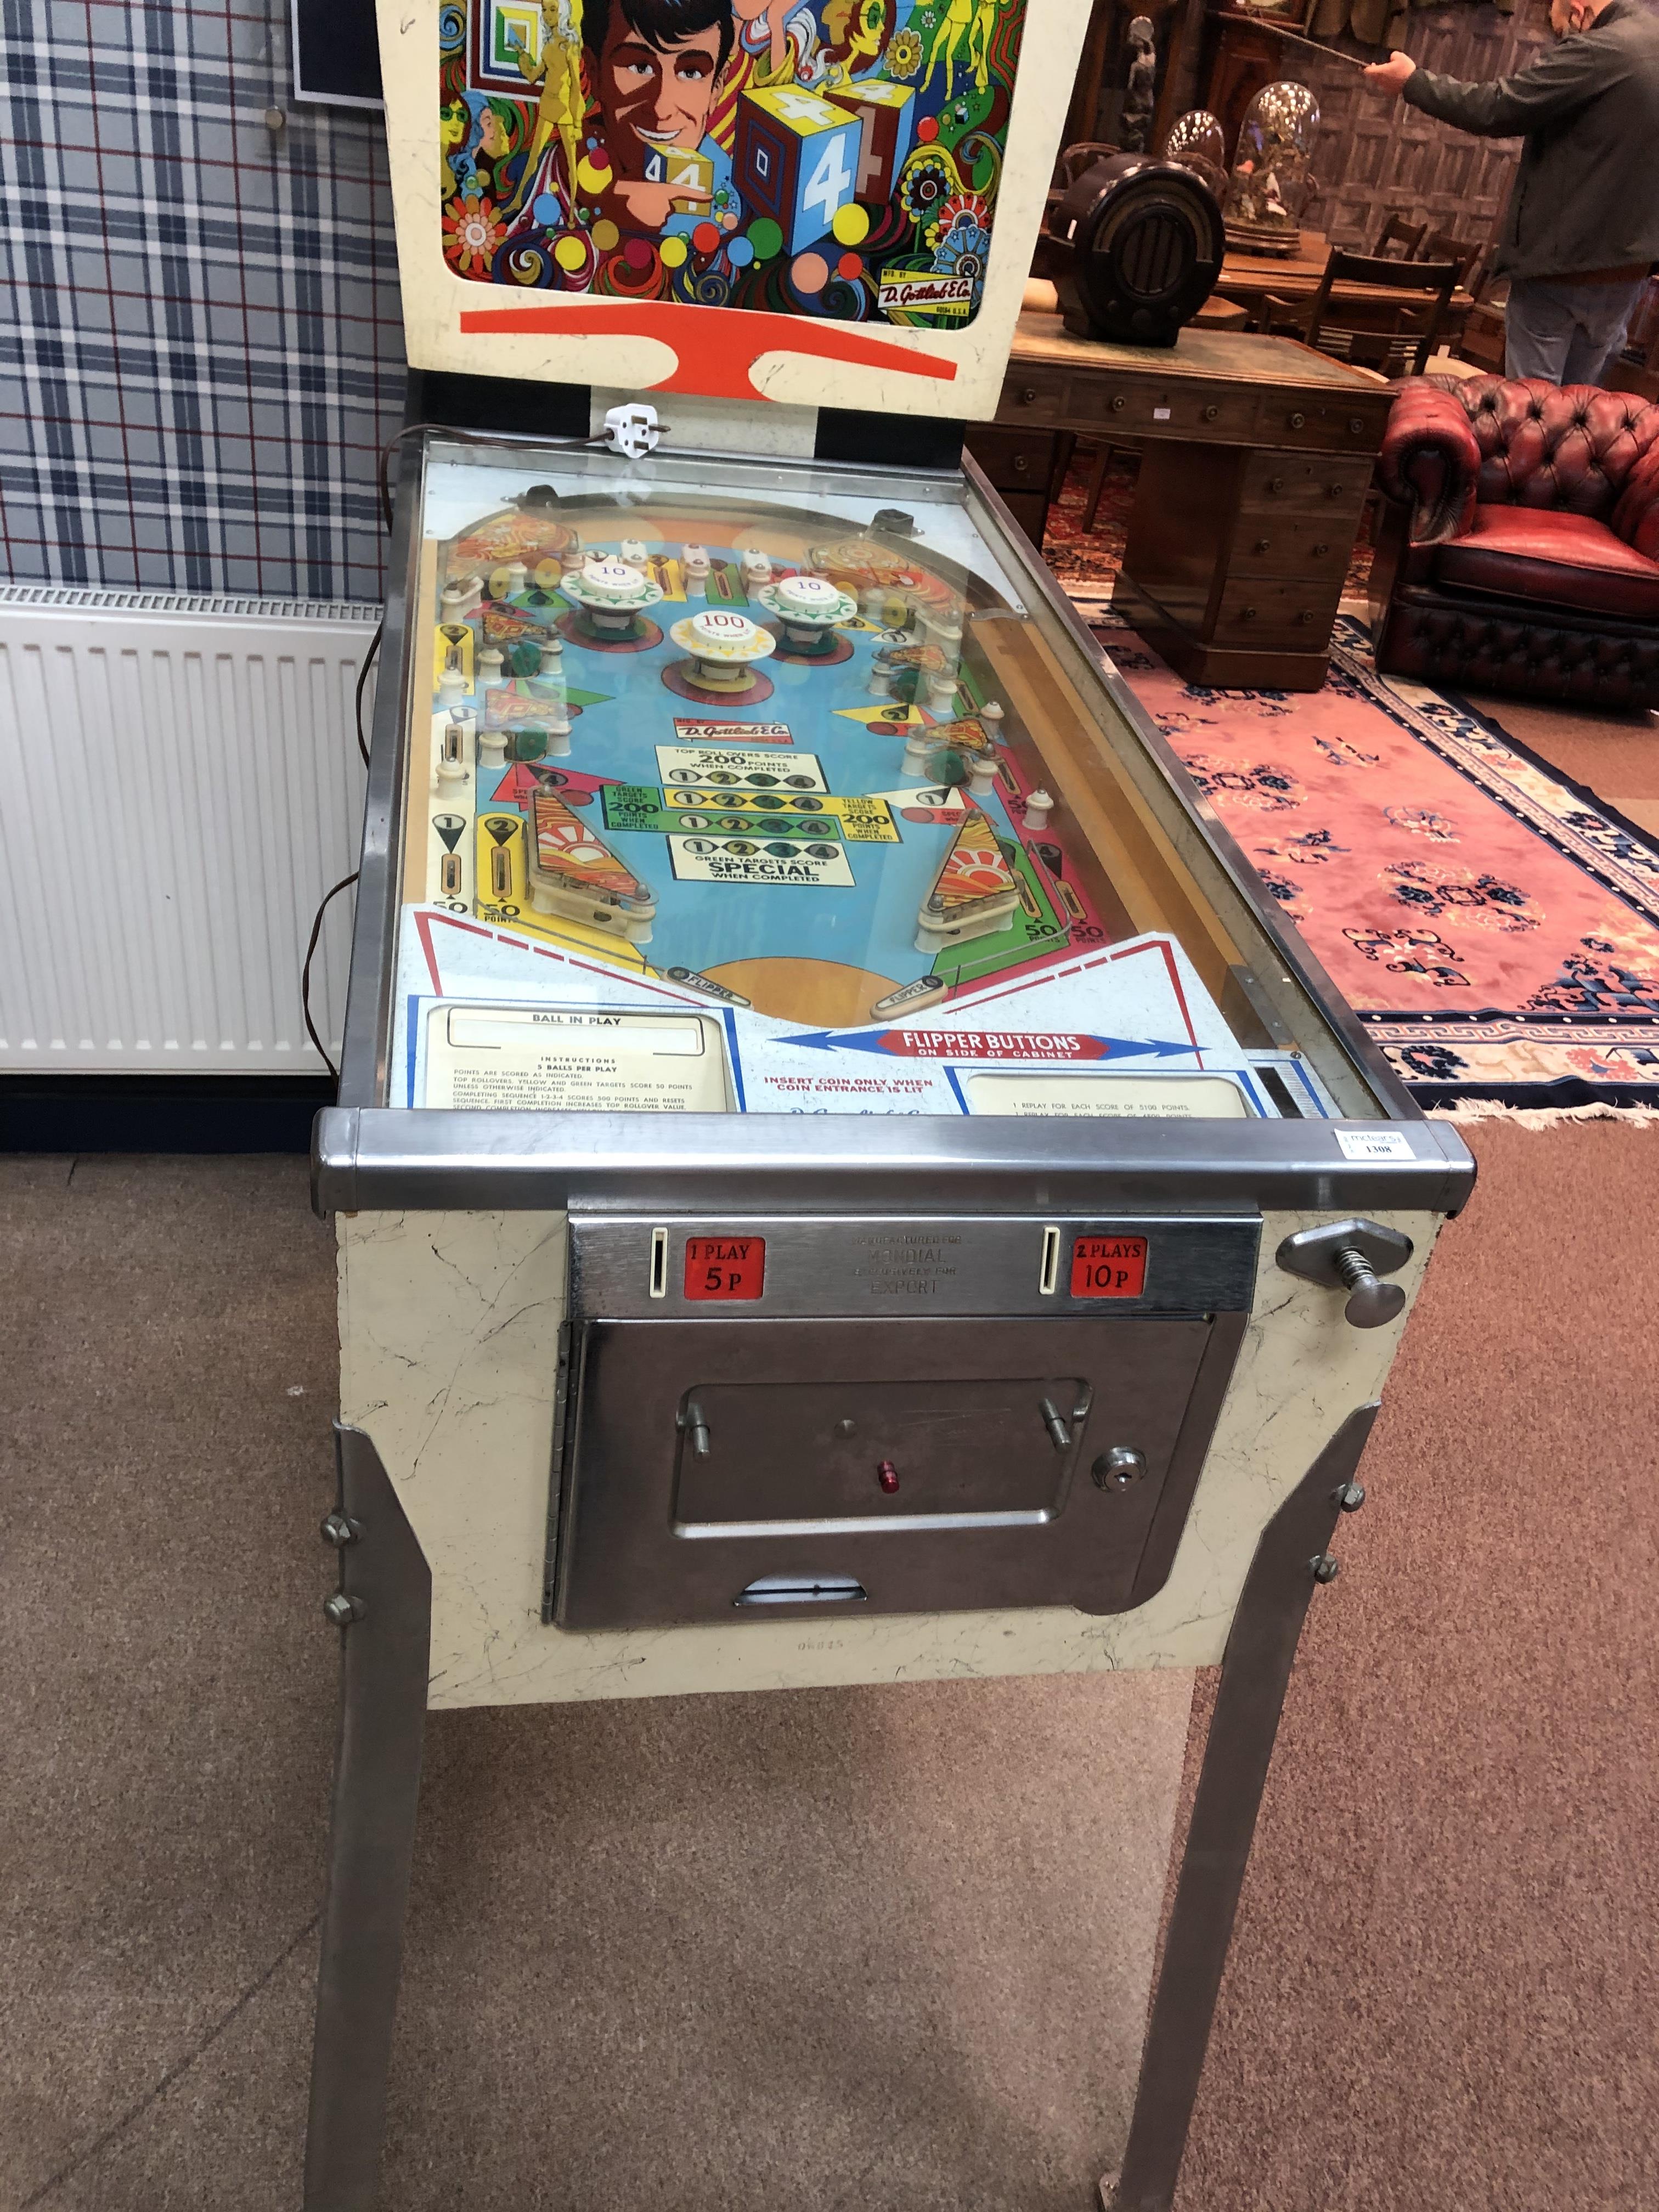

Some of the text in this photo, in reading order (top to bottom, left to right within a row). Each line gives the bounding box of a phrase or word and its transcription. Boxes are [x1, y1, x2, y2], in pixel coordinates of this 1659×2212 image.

[769, 91, 836, 126] 4
[803, 133, 851, 225] 4
[670, 164, 706, 211] 4
[900, 282, 949, 305] Gottlieb
[601, 567, 626, 576] 10
[797, 581, 821, 591] 10
[702, 614, 744, 628] 100
[888, 711, 900, 720] 2
[703, 726, 759, 738] Gottlieb
[699, 754, 747, 765] 200
[679, 771, 689, 782] 1
[716, 773, 731, 785] 2
[684, 793, 693, 804] 1
[721, 795, 737, 806] 2
[926, 795, 935, 805] 1
[608, 802, 659, 814] 200
[443, 817, 453, 829] 1
[493, 819, 510, 832] 2
[688, 816, 698, 828] 1
[727, 819, 742, 830] 2
[840, 814, 890, 825] 200
[693, 841, 703, 852] 1
[733, 843, 748, 855] 2
[708, 861, 820, 876] SPECIAL
[752, 874, 820, 882] COMPLETED
[483, 904, 521, 917] 50
[1024, 924, 1058, 936] 50
[1070, 925, 1104, 938] 50
[687, 975, 734, 998] FLIPPER
[533, 1014, 622, 1025] BALL IN PLAY
[902, 1031, 1081, 1051] FLIPPER BUTTONS
[1012, 1050, 1073, 1059] CABINET
[763, 1076, 814, 1085] INSERT
[818, 1077, 851, 1086] COIN
[854, 1078, 888, 1086] ONLY
[815, 1085, 884, 1093] ENTRANCE
[1365, 1145, 1393, 1154] 1308
[941, 1235, 962, 1244] FOR
[691, 1244, 751, 1260] 1 PLAY
[868, 1248, 946, 1264] MONDIAL
[1076, 1244, 1142, 1259] 2 PLAYS
[935, 1266, 957, 1276] FOR
[871, 1279, 942, 1295] EXPORT
